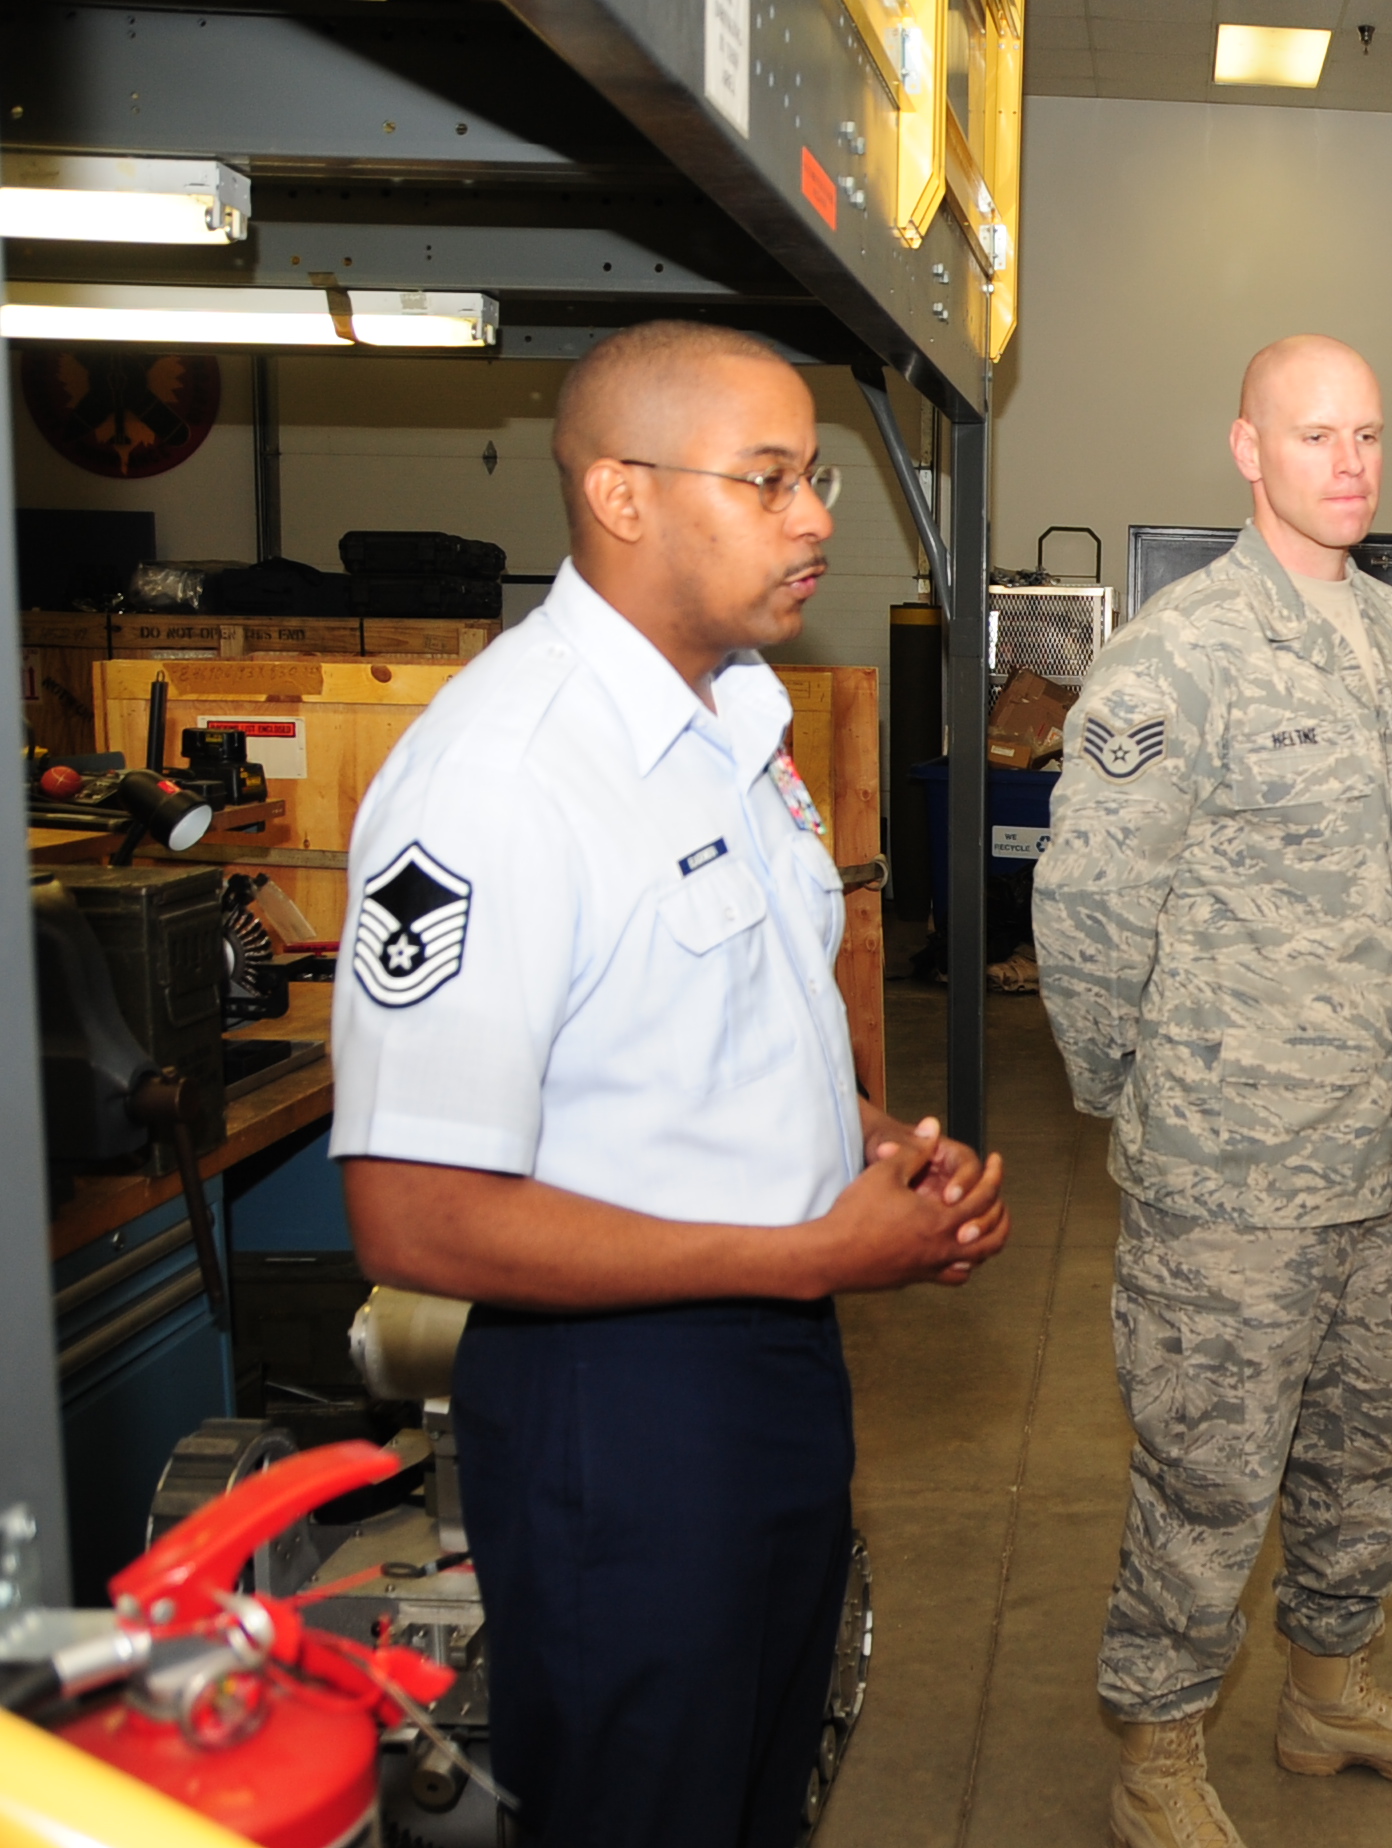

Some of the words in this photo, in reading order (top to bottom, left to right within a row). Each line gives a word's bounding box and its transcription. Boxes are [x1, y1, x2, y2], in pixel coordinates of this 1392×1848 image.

[140, 626, 161, 639] DO
[166, 627, 194, 640] NOT
[278, 629, 306, 641] END
[258, 725, 292, 734] ENCLOSED
[1004, 833, 1018, 841] WE
[994, 843, 1031, 852] RECYCLE
